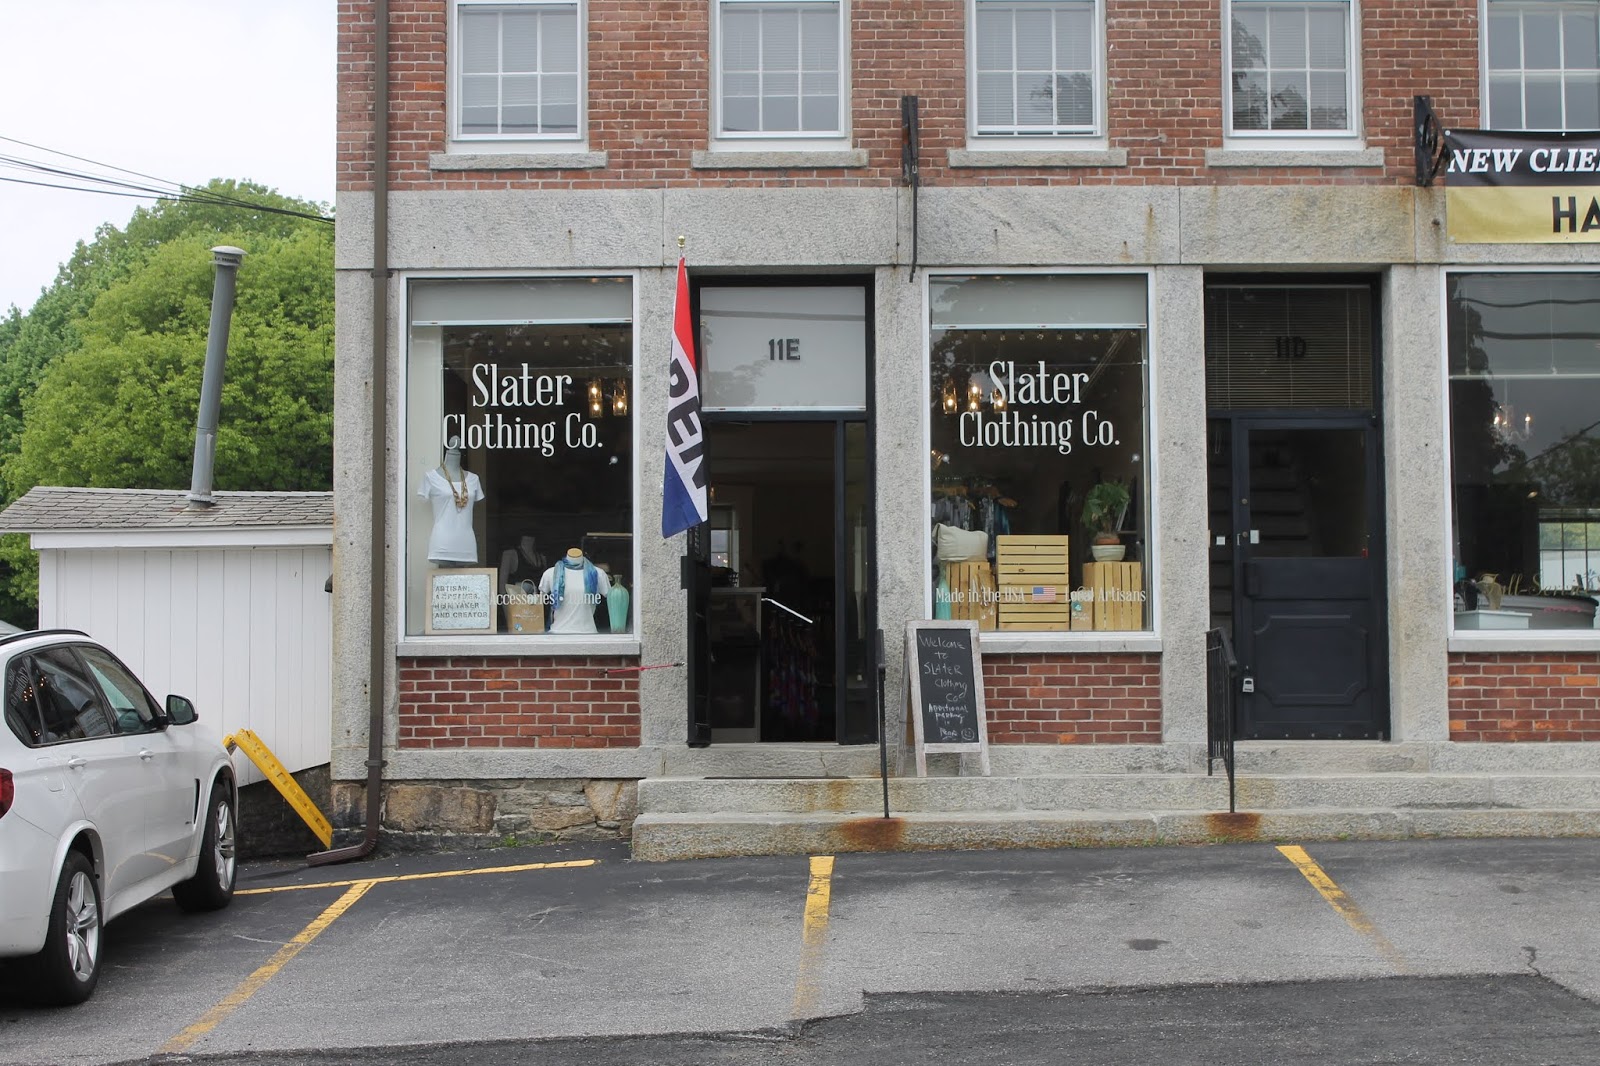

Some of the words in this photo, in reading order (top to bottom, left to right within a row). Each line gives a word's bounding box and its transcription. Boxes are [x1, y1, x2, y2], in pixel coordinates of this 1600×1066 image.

[1447, 148, 1523, 173] NEW
[1529, 148, 1600, 173] CLIE
[768, 338, 801, 361] 11E
[472, 362, 572, 407] Slater
[989, 360, 1089, 404] Slater
[443, 413, 556, 457] Clothing
[565, 412, 604, 448] Co.
[959, 410, 1073, 454] Clothing
[1082, 410, 1120, 446] Co.
[936, 587, 965, 603] Made
[983, 586, 1001, 603] the
[1004, 587, 1026, 603] USA
[1098, 586, 1146, 602] Artisans
